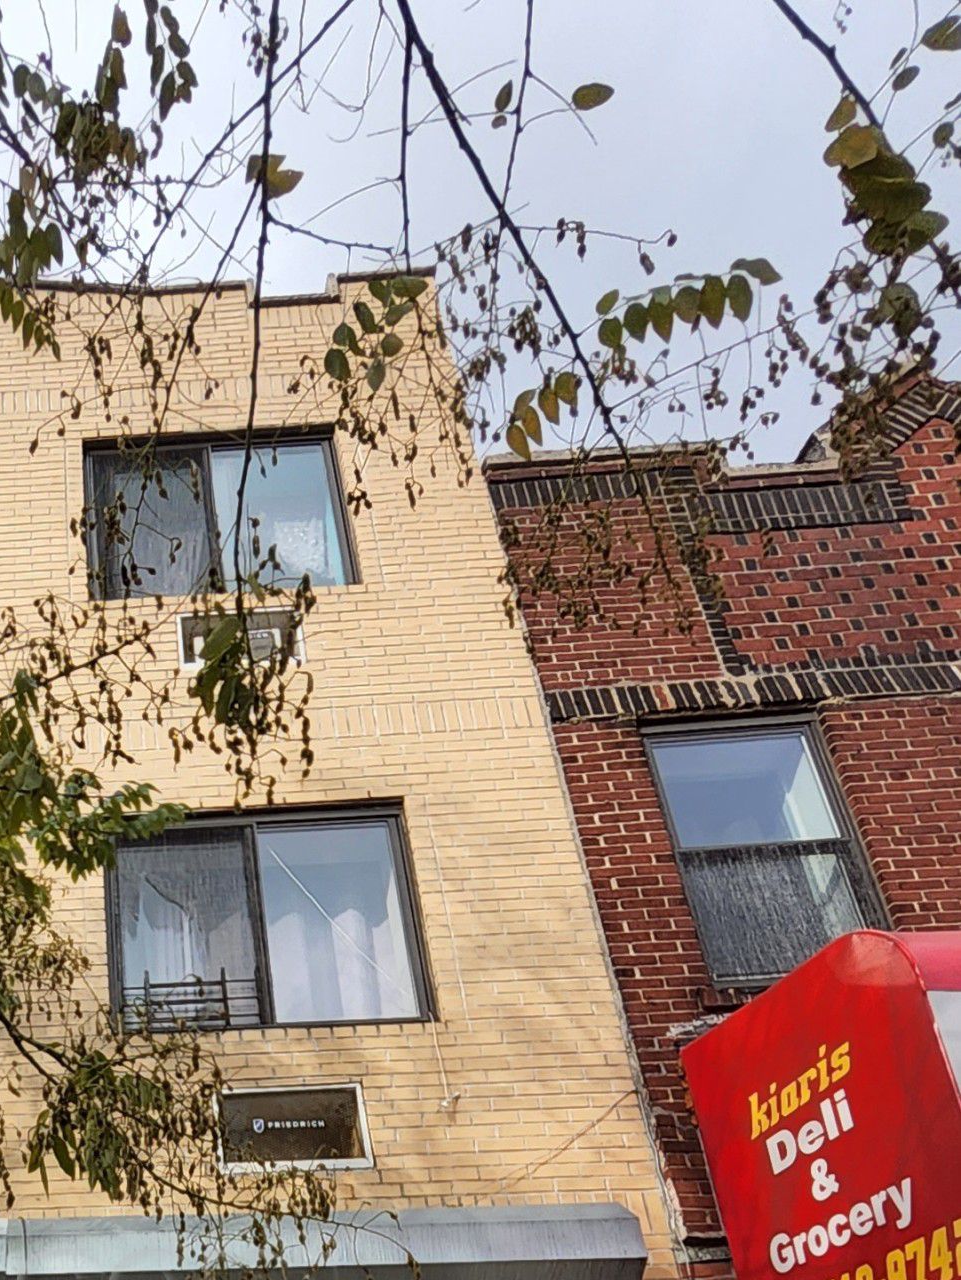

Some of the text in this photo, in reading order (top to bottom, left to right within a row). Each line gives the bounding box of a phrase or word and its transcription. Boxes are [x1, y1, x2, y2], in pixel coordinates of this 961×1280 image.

[267, 1119, 325, 1129] FRIEDRICH
[766, 1088, 854, 1176] Deli
[810, 1158, 840, 1202] &
[769, 1177, 912, 1274] Grocery
